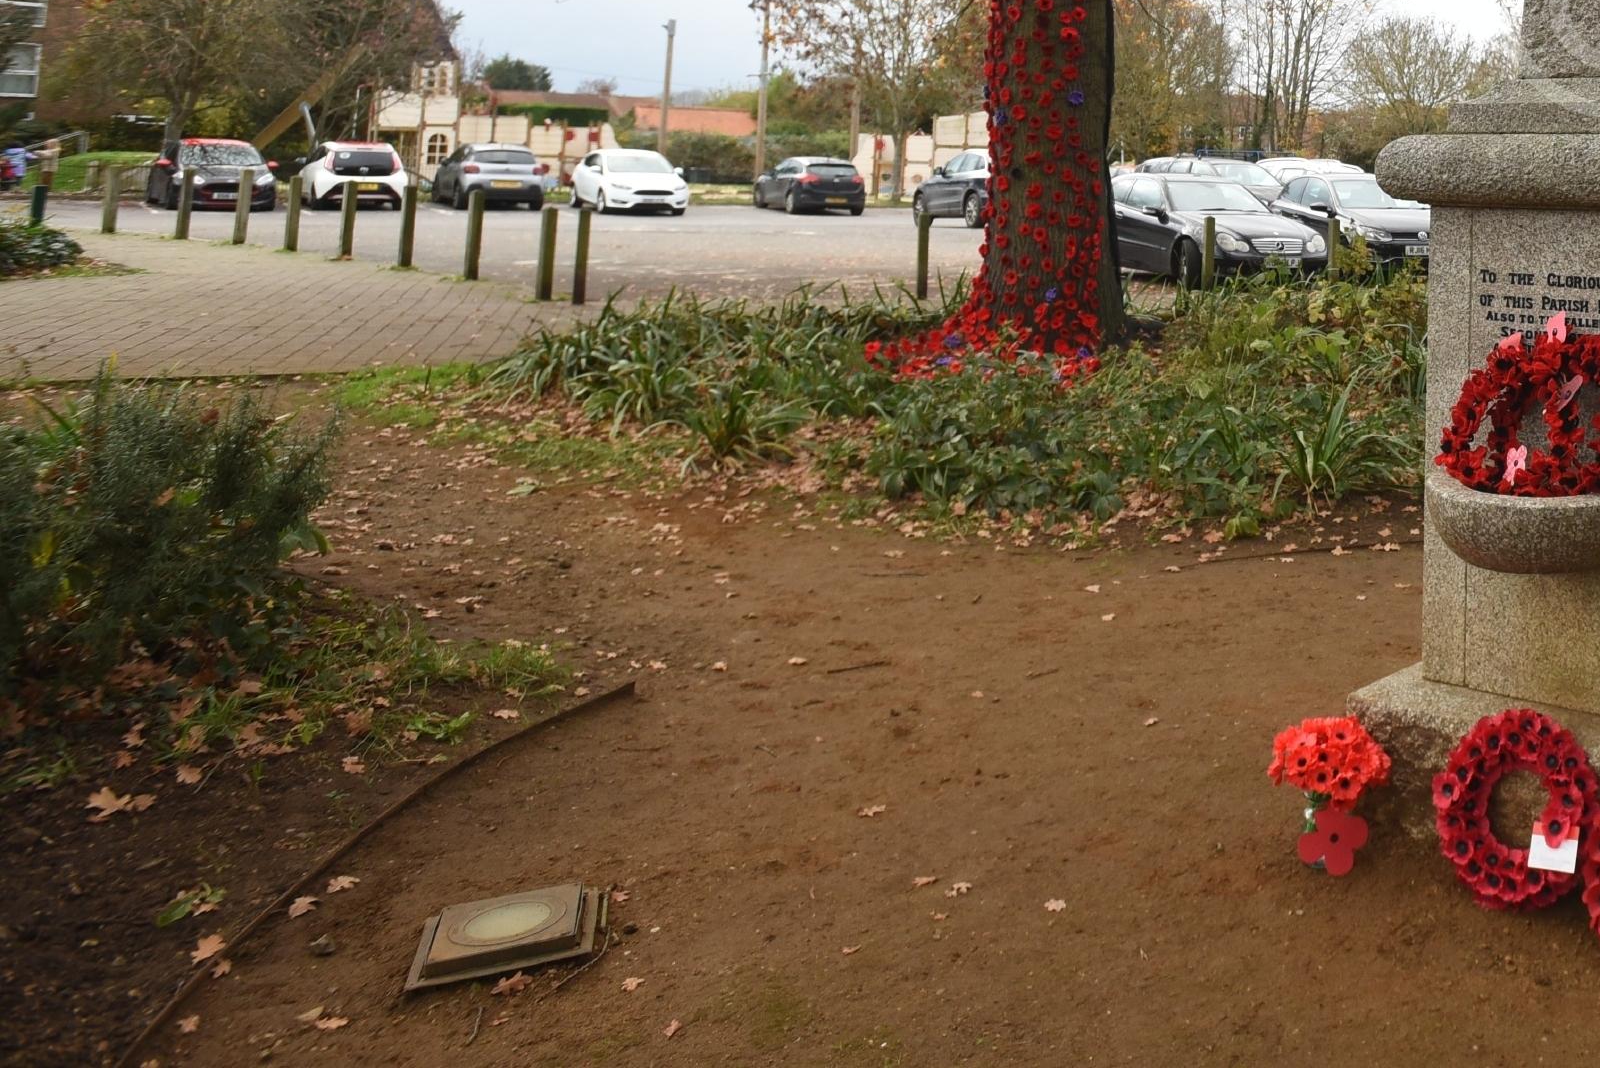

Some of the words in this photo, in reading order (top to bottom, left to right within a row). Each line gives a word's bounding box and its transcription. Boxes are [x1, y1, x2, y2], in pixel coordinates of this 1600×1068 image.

[1508, 272, 1535, 286] THE
[1479, 294, 1495, 307] OF
[1503, 295, 1534, 310] THIS
[1541, 296, 1589, 313] PARISH
[1486, 311, 1516, 323] ALSO
[1519, 314, 1535, 324] TO
